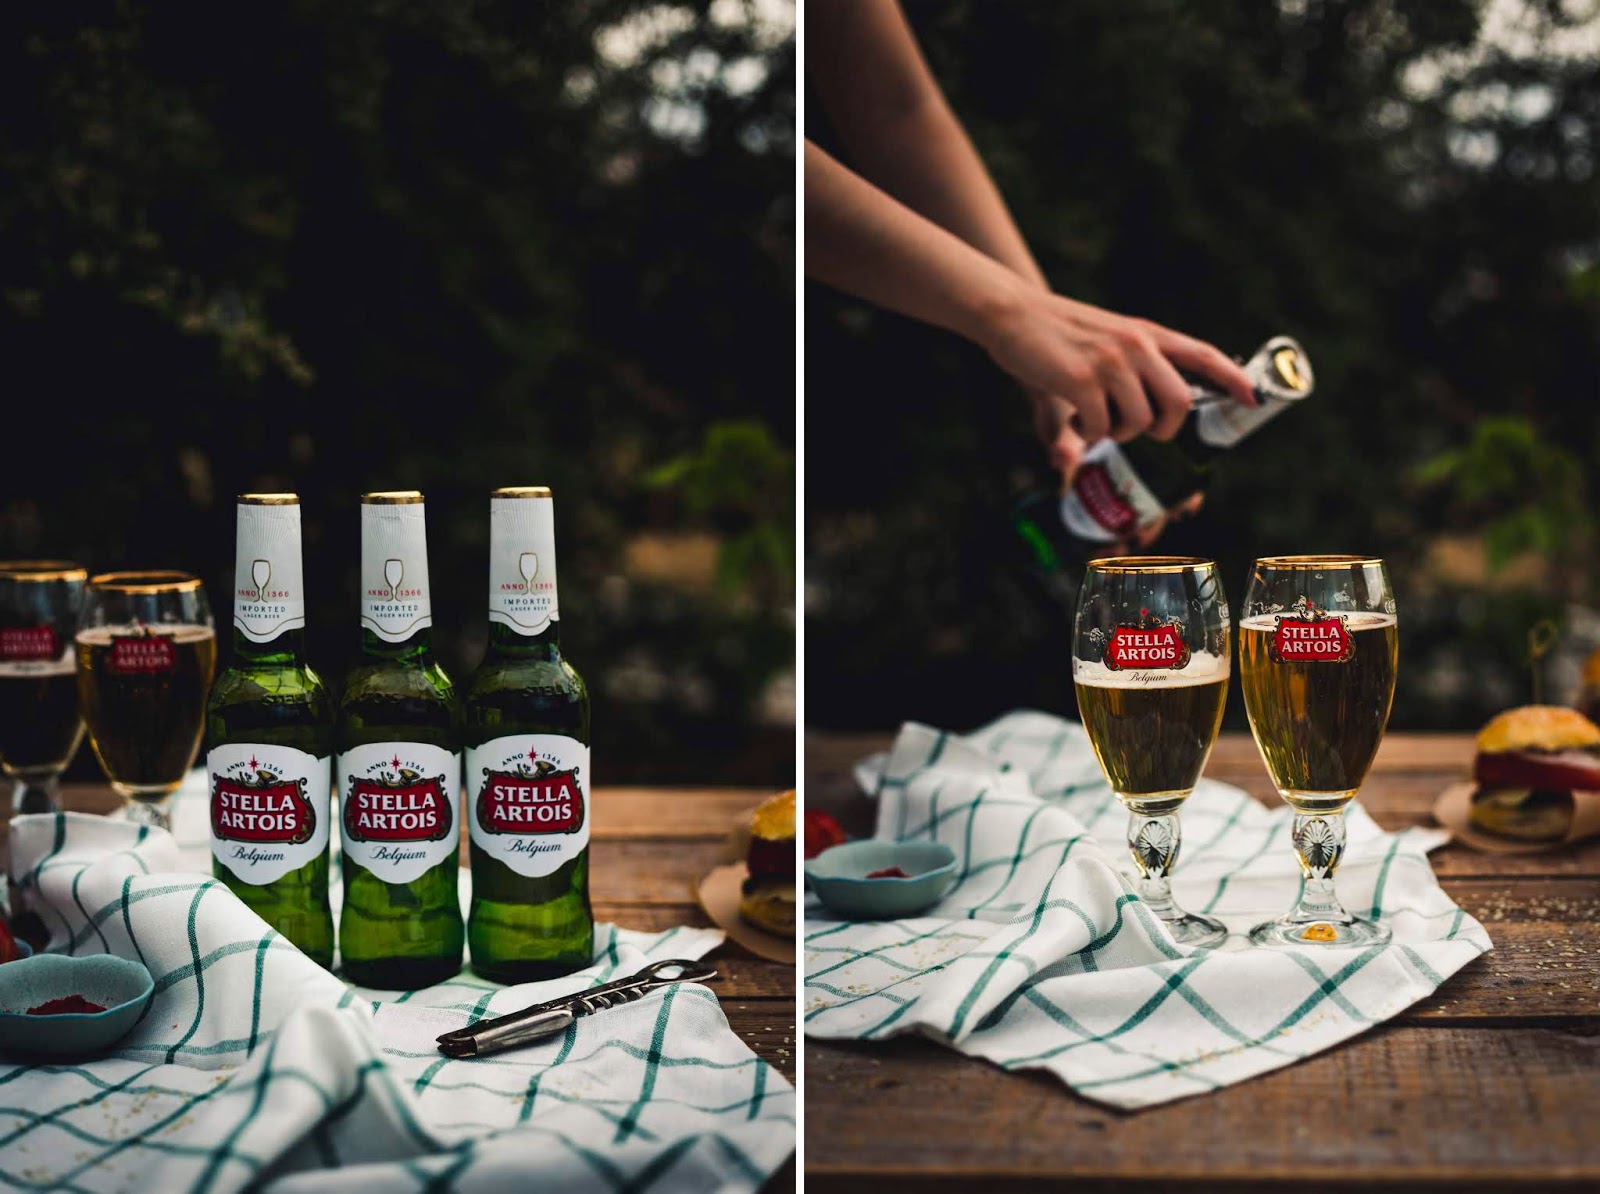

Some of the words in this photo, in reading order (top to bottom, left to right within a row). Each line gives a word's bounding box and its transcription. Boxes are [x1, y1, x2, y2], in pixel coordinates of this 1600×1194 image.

[368, 589, 390, 597] ANNO
[400, 589, 422, 597] 1366
[501, 582, 525, 590] ANNO
[238, 589, 256, 597] ANNO
[267, 590, 289, 598] 1366
[239, 605, 286, 613] IMPORTED
[370, 604, 419, 612] IMPORTED
[1281, 626, 1340, 639] STELLA
[1117, 633, 1175, 647] STELLA
[1281, 640, 1342, 653] ARTOIS
[116, 643, 169, 654] STELLA
[1117, 647, 1176, 661] ARTOIS
[117, 655, 171, 667] ARTOIS
[1125, 671, 1168, 685] Belgium
[502, 752, 525, 767] ANNO
[541, 752, 562, 765] 1366
[226, 761, 246, 774] ANNO
[262, 762, 284, 775] 1366
[365, 760, 388, 775] ANNO
[405, 761, 425, 773] 1366
[493, 784, 572, 803] STELLA
[220, 791, 296, 811] STELLA
[358, 792, 437, 811] STELLA
[493, 803, 572, 822] ARTOIS
[220, 810, 297, 831] ARTOIS
[358, 810, 437, 830] ARTOIS
[230, 844, 285, 866] Belgium
[504, 839, 562, 858] Belgium
[368, 846, 428, 866] Belgium
